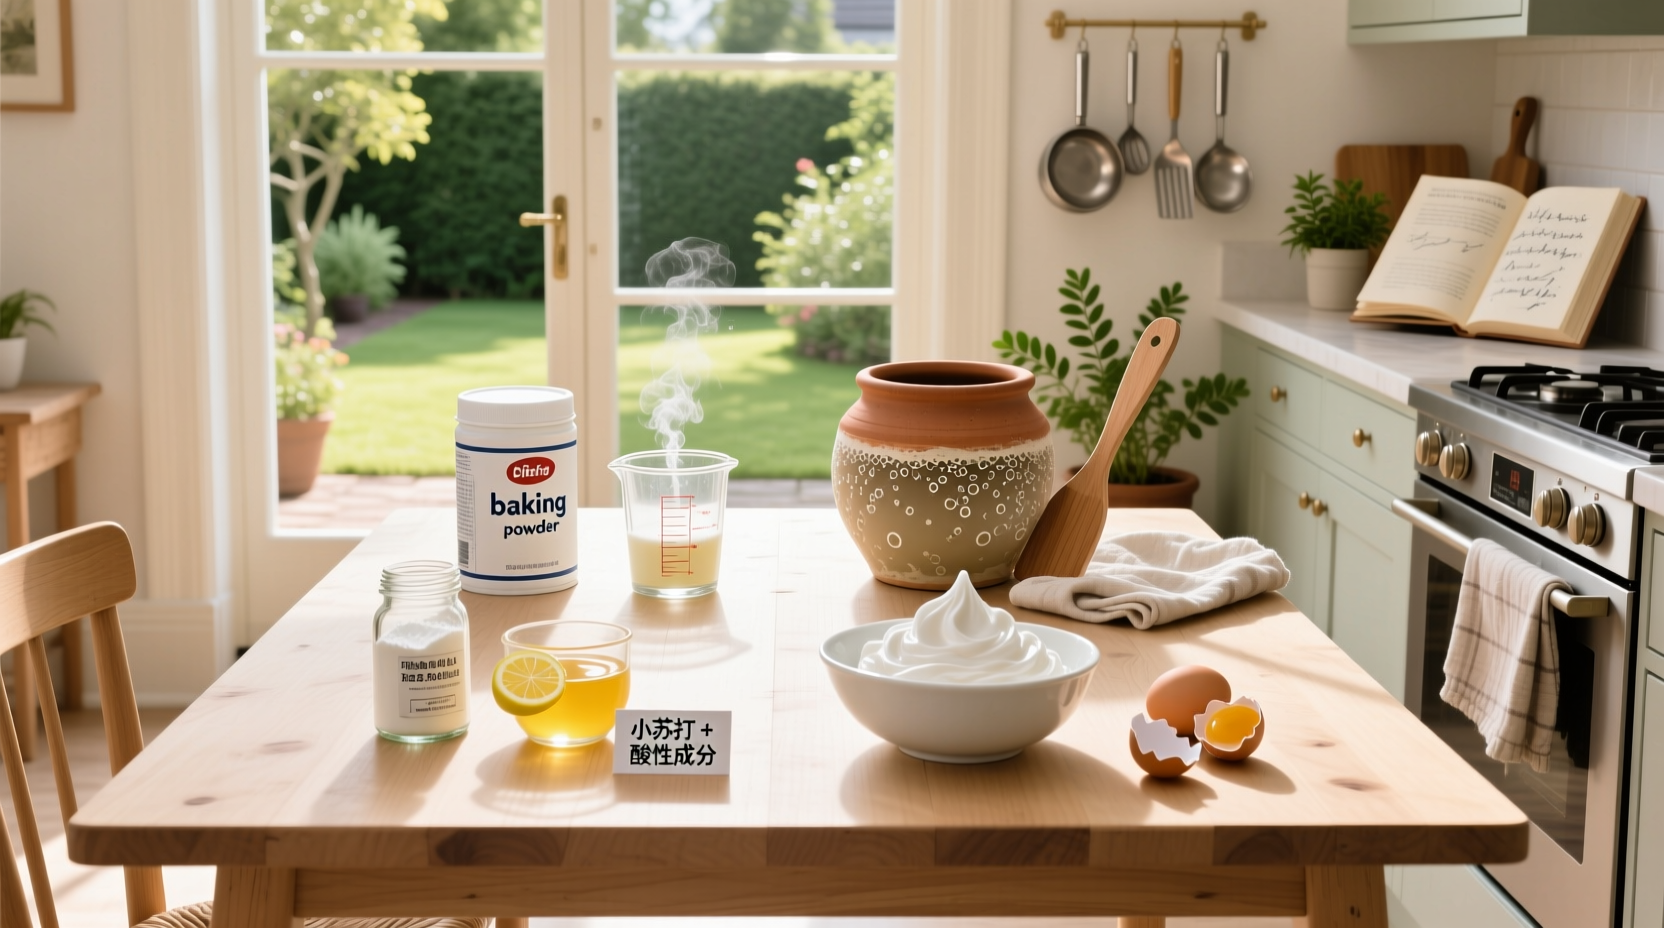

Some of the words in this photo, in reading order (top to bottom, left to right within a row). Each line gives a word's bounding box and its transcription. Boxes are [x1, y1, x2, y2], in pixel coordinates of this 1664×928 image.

[490, 492, 567, 518] baking
[503, 519, 560, 540] powder
[631, 717, 696, 740] 小苏打
[629, 743, 717, 767] 酸性成分
